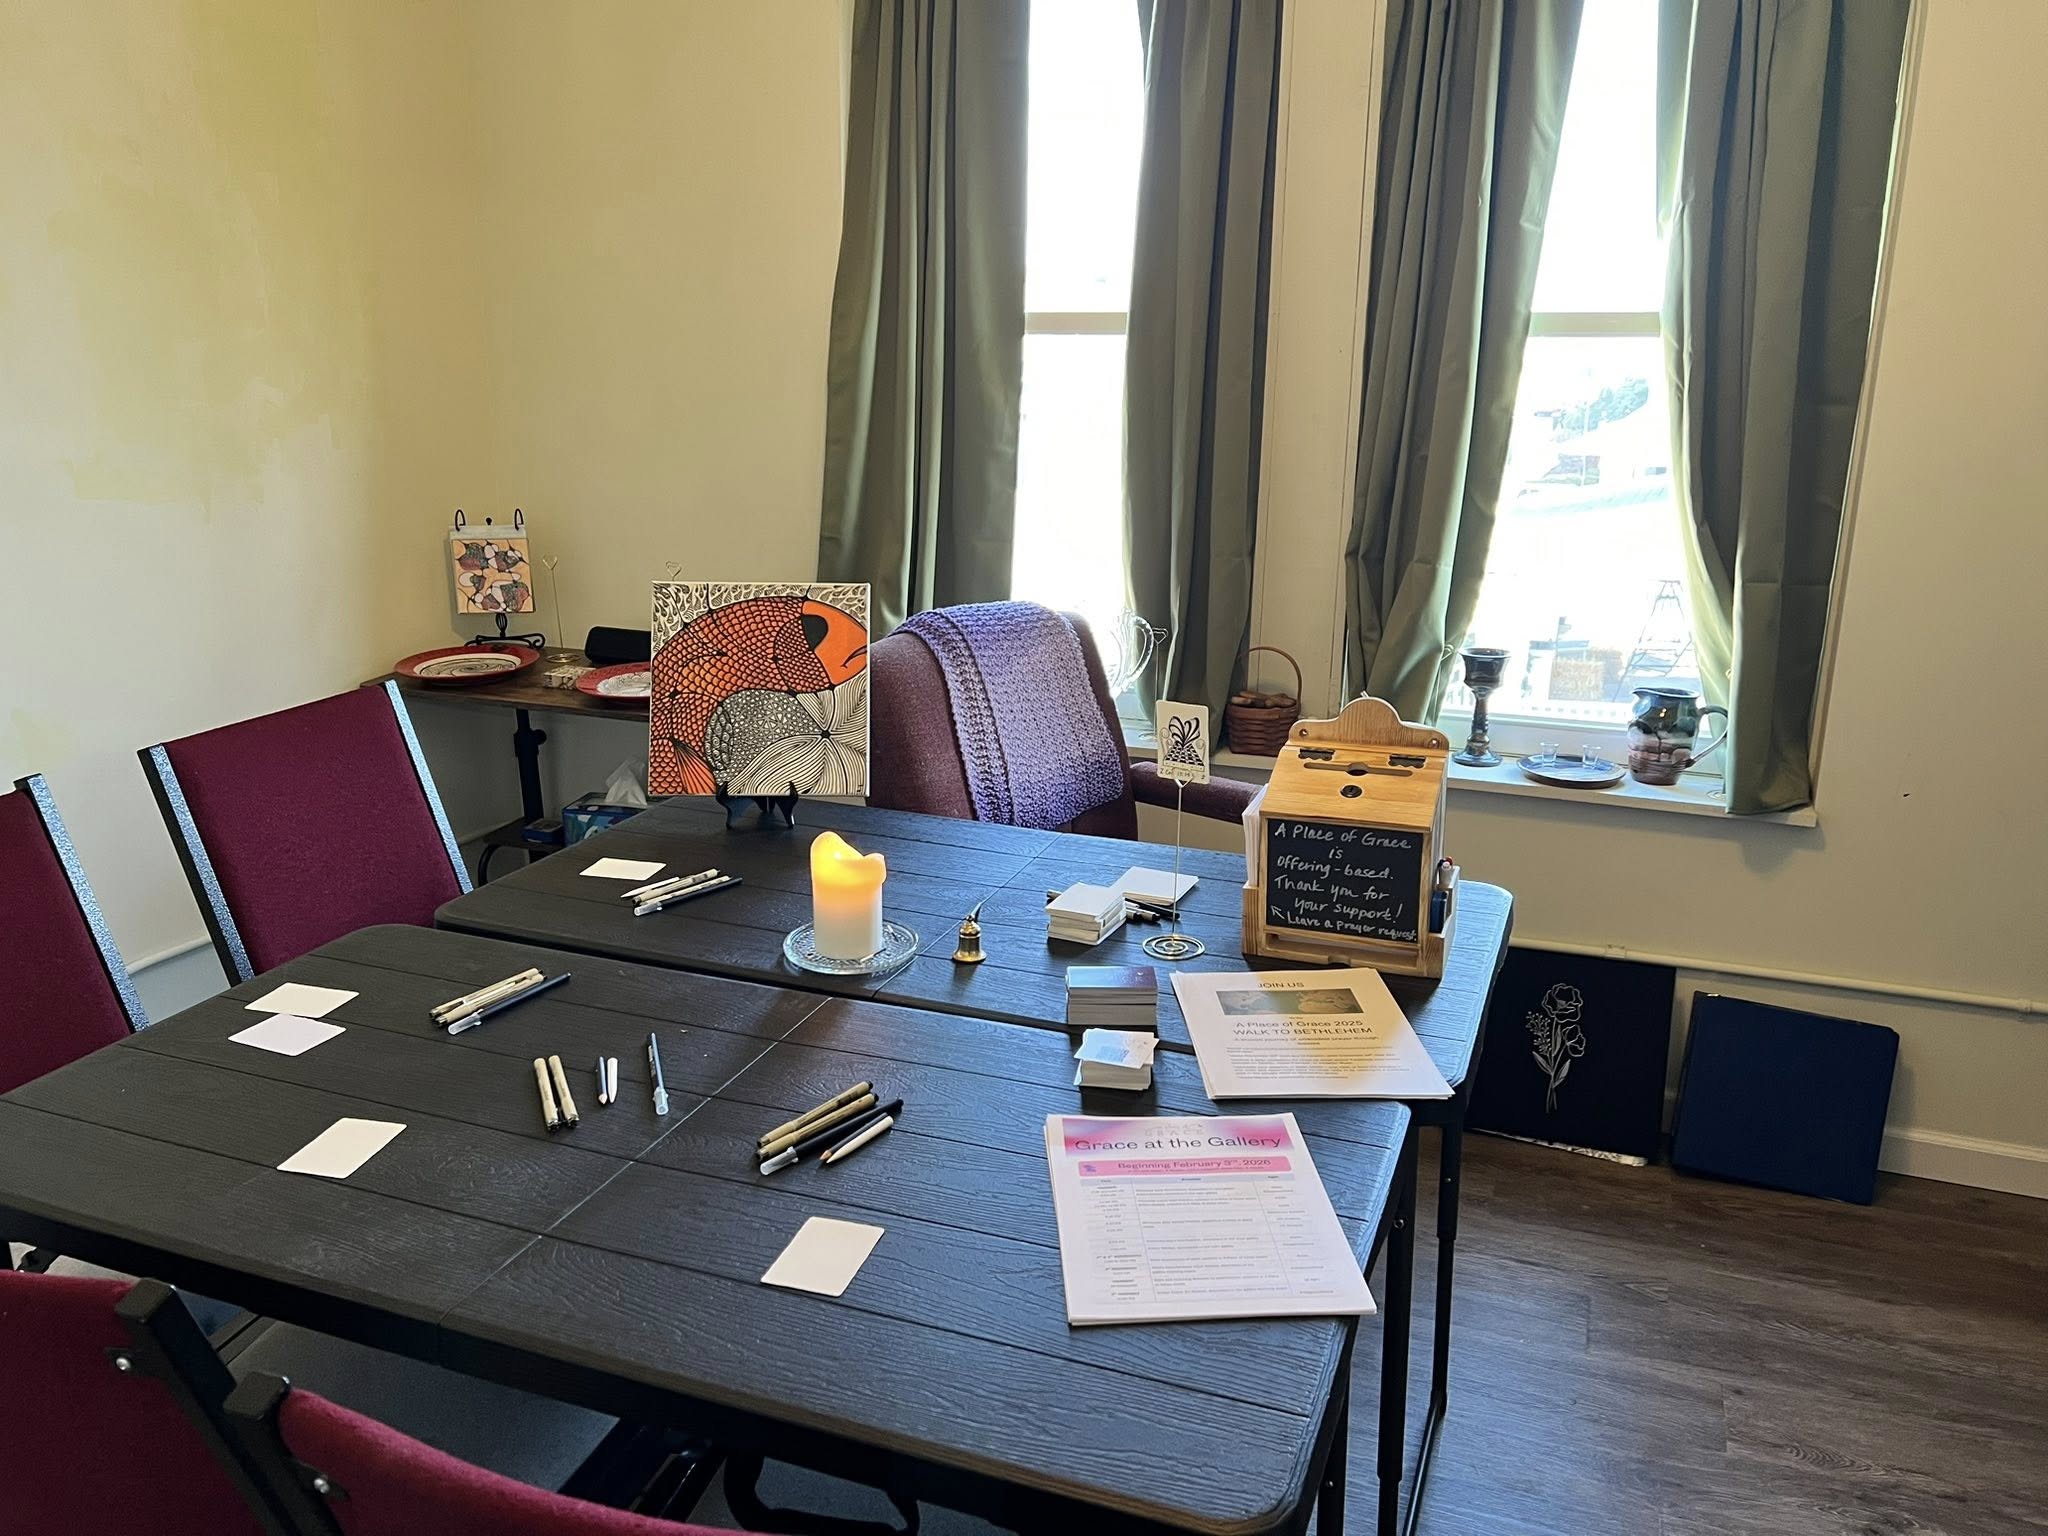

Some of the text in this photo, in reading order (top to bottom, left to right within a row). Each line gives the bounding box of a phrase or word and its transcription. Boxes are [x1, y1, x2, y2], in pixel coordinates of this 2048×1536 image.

[1274, 822, 1412, 849] A Place of Grace
[1328, 846, 1344, 860] is
[1274, 874, 1390, 902] Thank you for
[1333, 902, 1403, 924] support!
[1287, 911, 1321, 927] Leave
[1324, 919, 1334, 928] a
[1336, 920, 1377, 935] prayer
[1233, 1028, 1270, 1036] WALK
[1294, 1026, 1373, 1035] BETHLEHEM
[1296, 1020, 1332, 1028] Grace
[1333, 1019, 1364, 1027] 2025
[1075, 1136, 1281, 1151] Grace at the Gallery
[1118, 1161, 1172, 1170] Beginning
[1173, 1160, 1221, 1169] February
